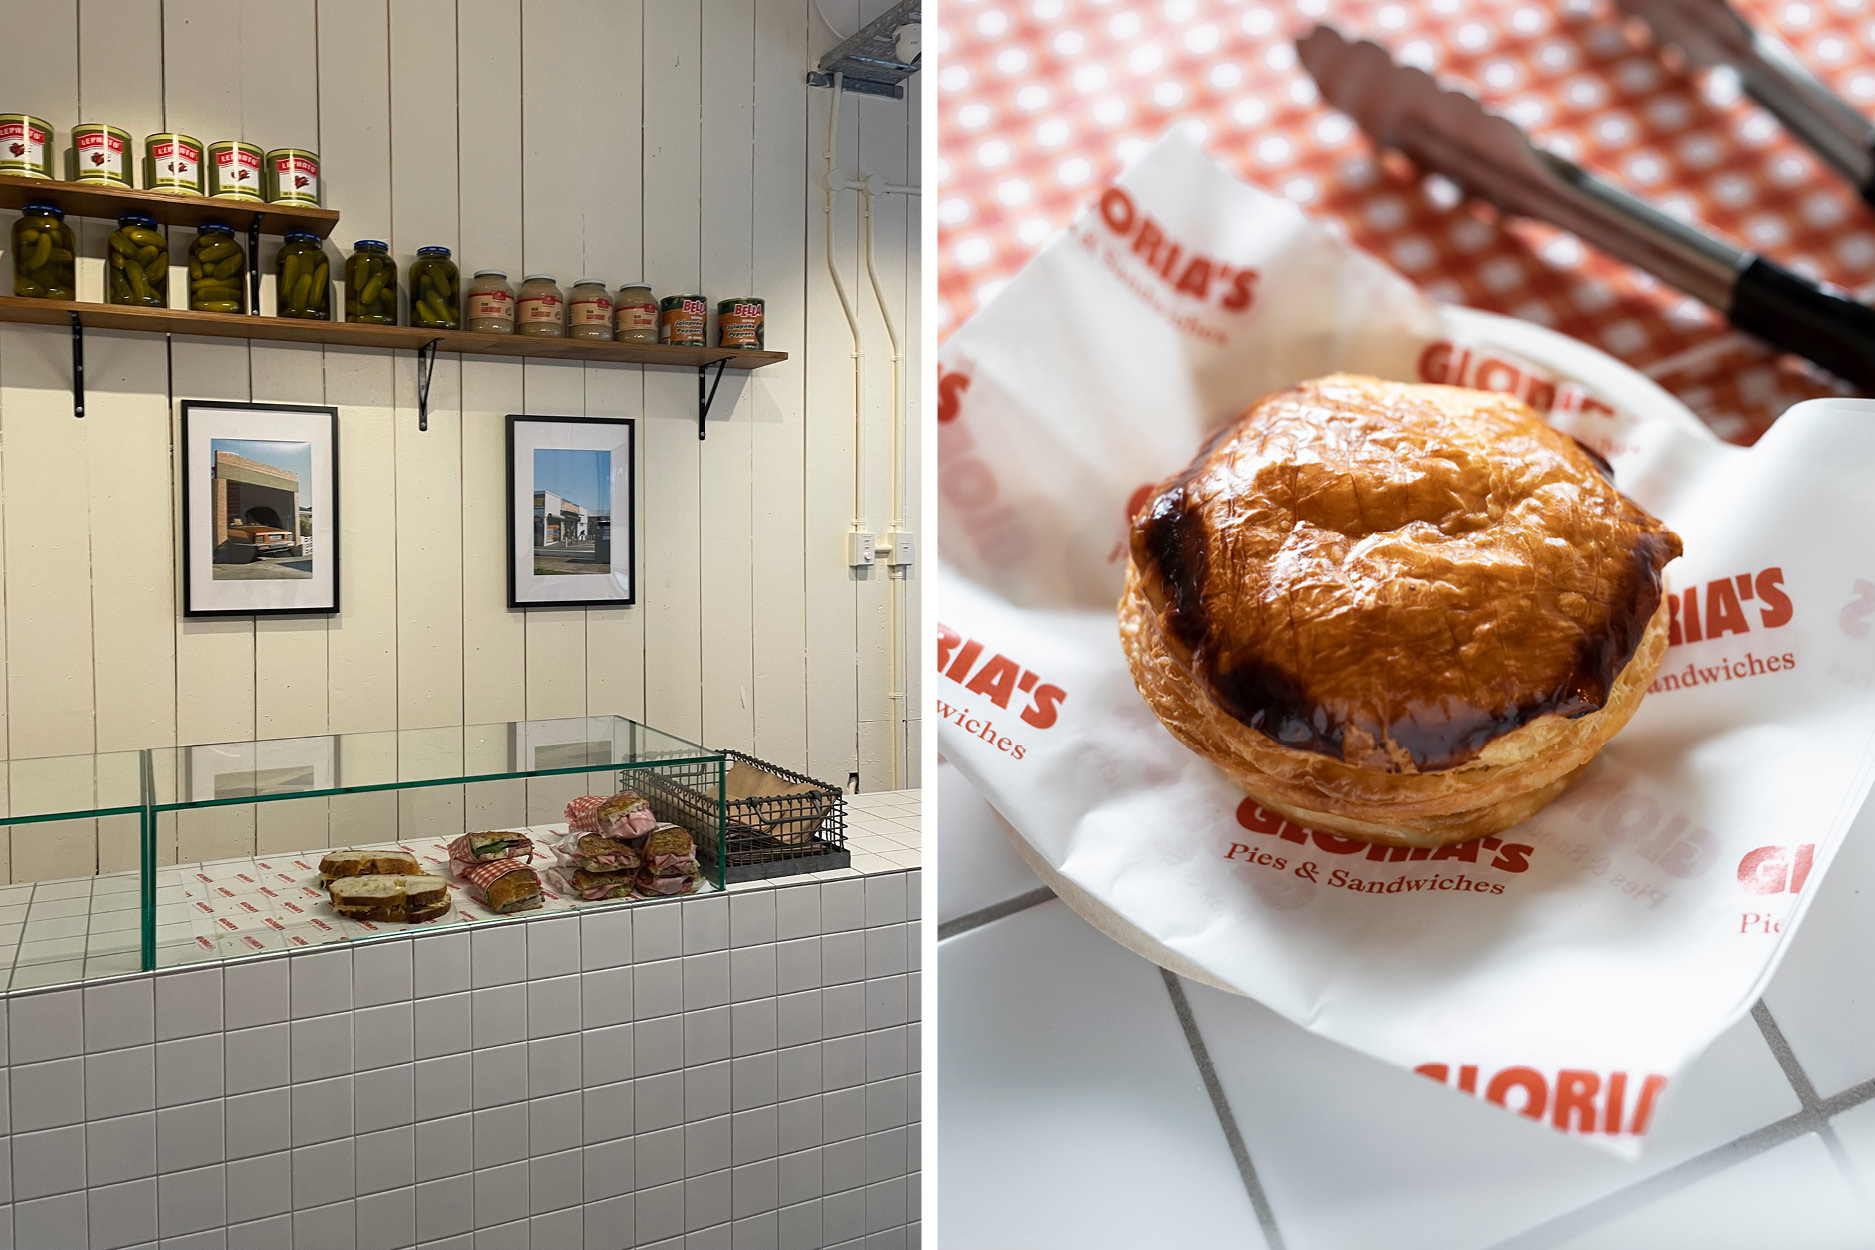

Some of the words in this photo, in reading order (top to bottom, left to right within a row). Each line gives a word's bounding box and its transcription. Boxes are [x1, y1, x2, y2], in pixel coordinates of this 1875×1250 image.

[158, 146, 197, 159] LEPNTO
[1224, 842, 1288, 871] Pies
[1294, 861, 1320, 883] &
[1328, 868, 1506, 895] Sandwiches
